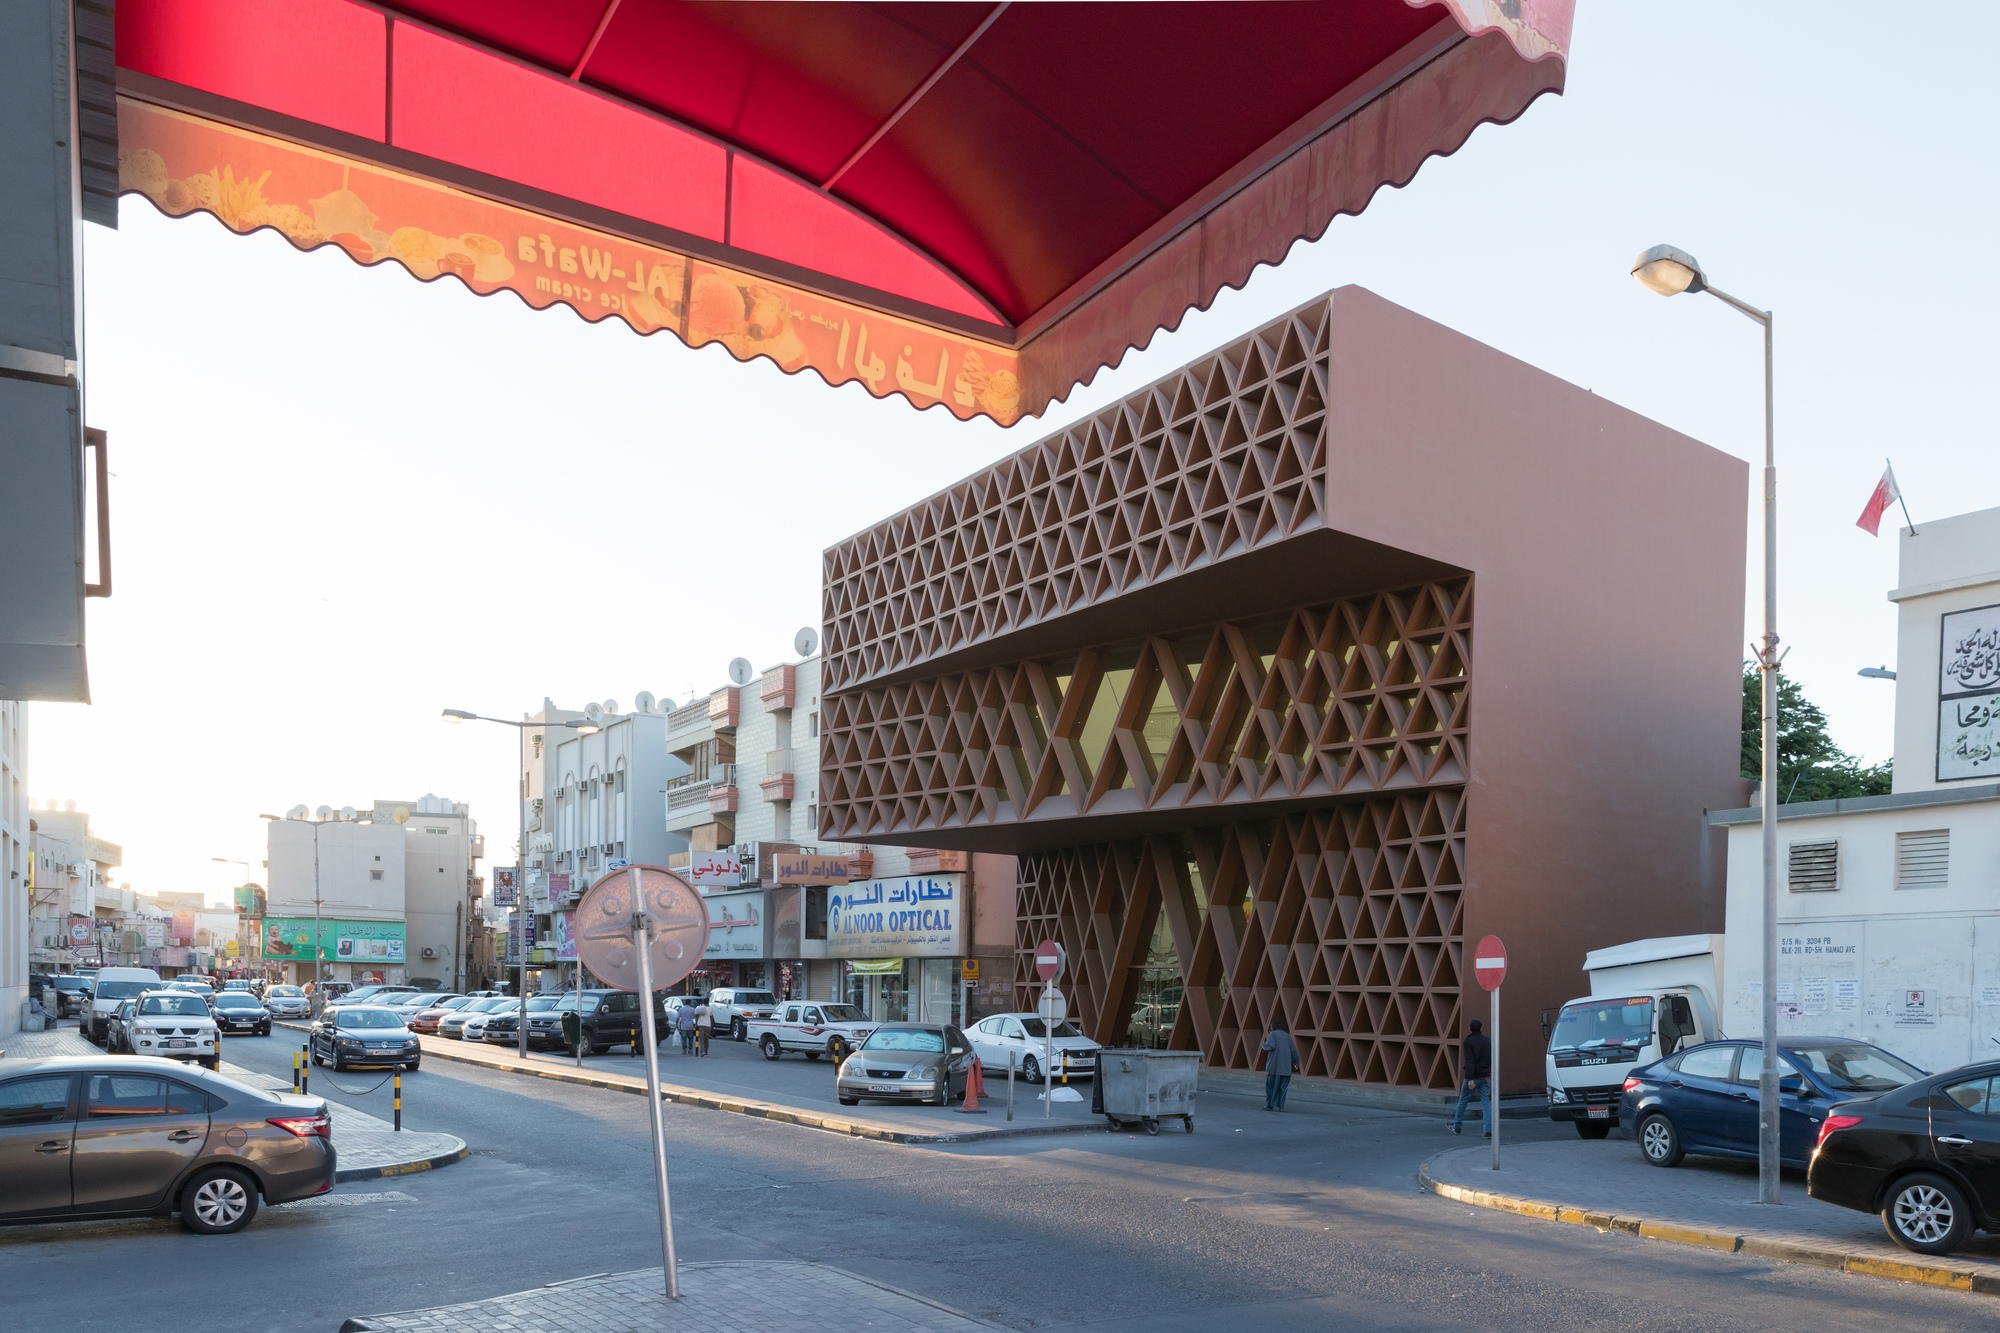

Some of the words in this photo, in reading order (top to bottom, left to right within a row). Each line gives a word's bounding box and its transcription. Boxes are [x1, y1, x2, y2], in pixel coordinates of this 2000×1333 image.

[692, 858, 740, 880] دلوني
[779, 859, 809, 878] النور
[810, 860, 847, 879] نظارات
[843, 882, 884, 911] النور
[887, 878, 953, 906] نظارات
[888, 909, 952, 932] OPTICAL
[1825, 945, 1844, 954] HAMAD
[1845, 945, 1856, 953] AVE
[1627, 997, 1649, 1005] UMAC
[1581, 1057, 1608, 1066] ISUZU
